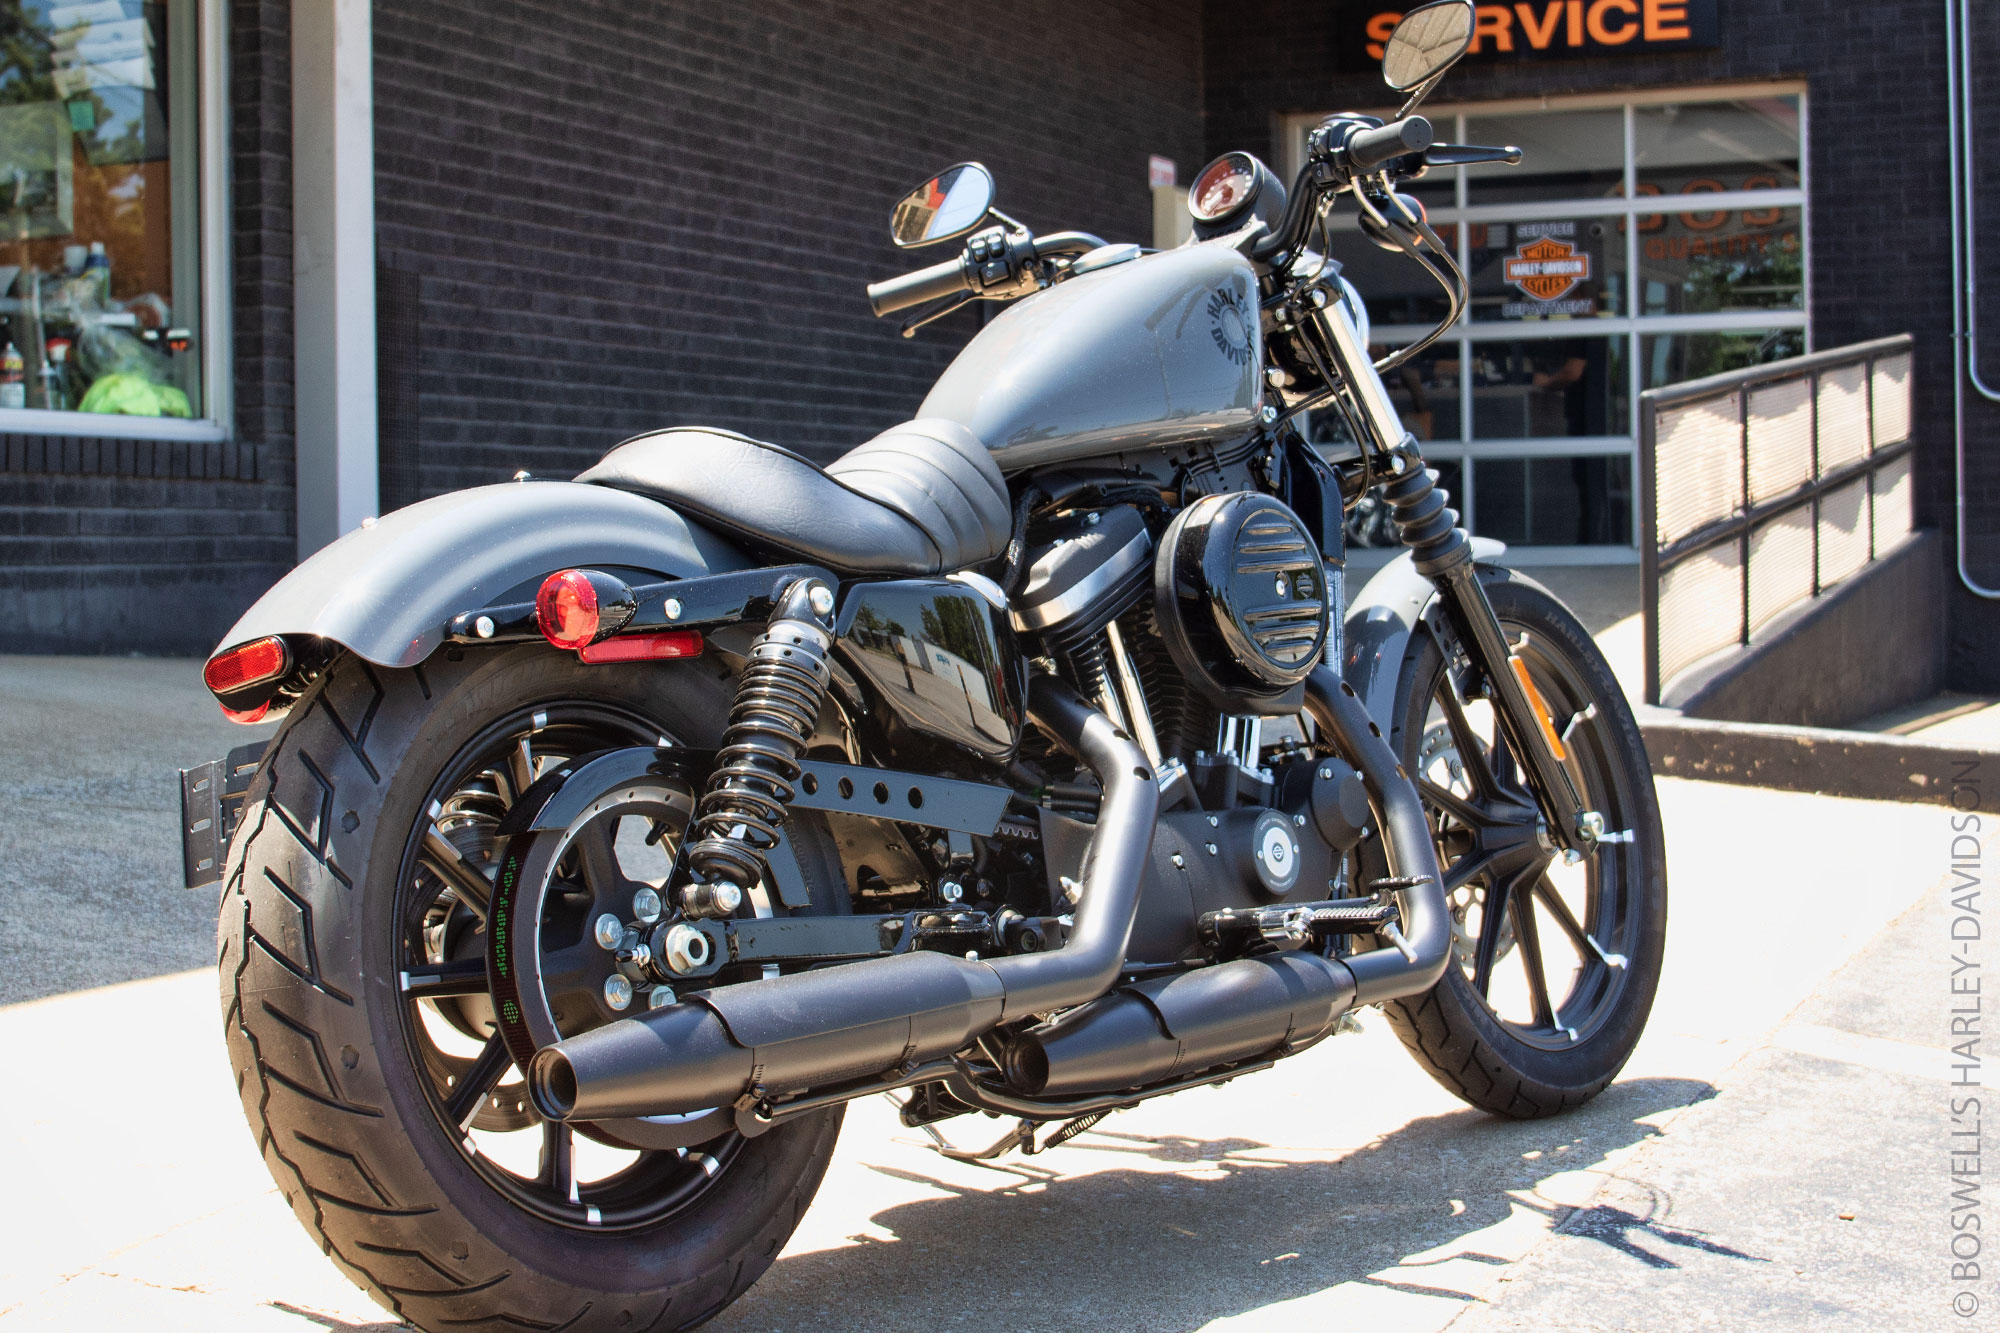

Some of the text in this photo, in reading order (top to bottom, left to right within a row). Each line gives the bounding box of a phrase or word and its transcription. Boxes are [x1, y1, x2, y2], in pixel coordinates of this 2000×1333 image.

[1365, 0, 1691, 61] SRVICE
[1616, 175, 1799, 232] BOS
[1517, 222, 1575, 237] SERVICE
[1645, 234, 1772, 260] QUALITY
[1502, 301, 1591, 316] DEPARTMENT
